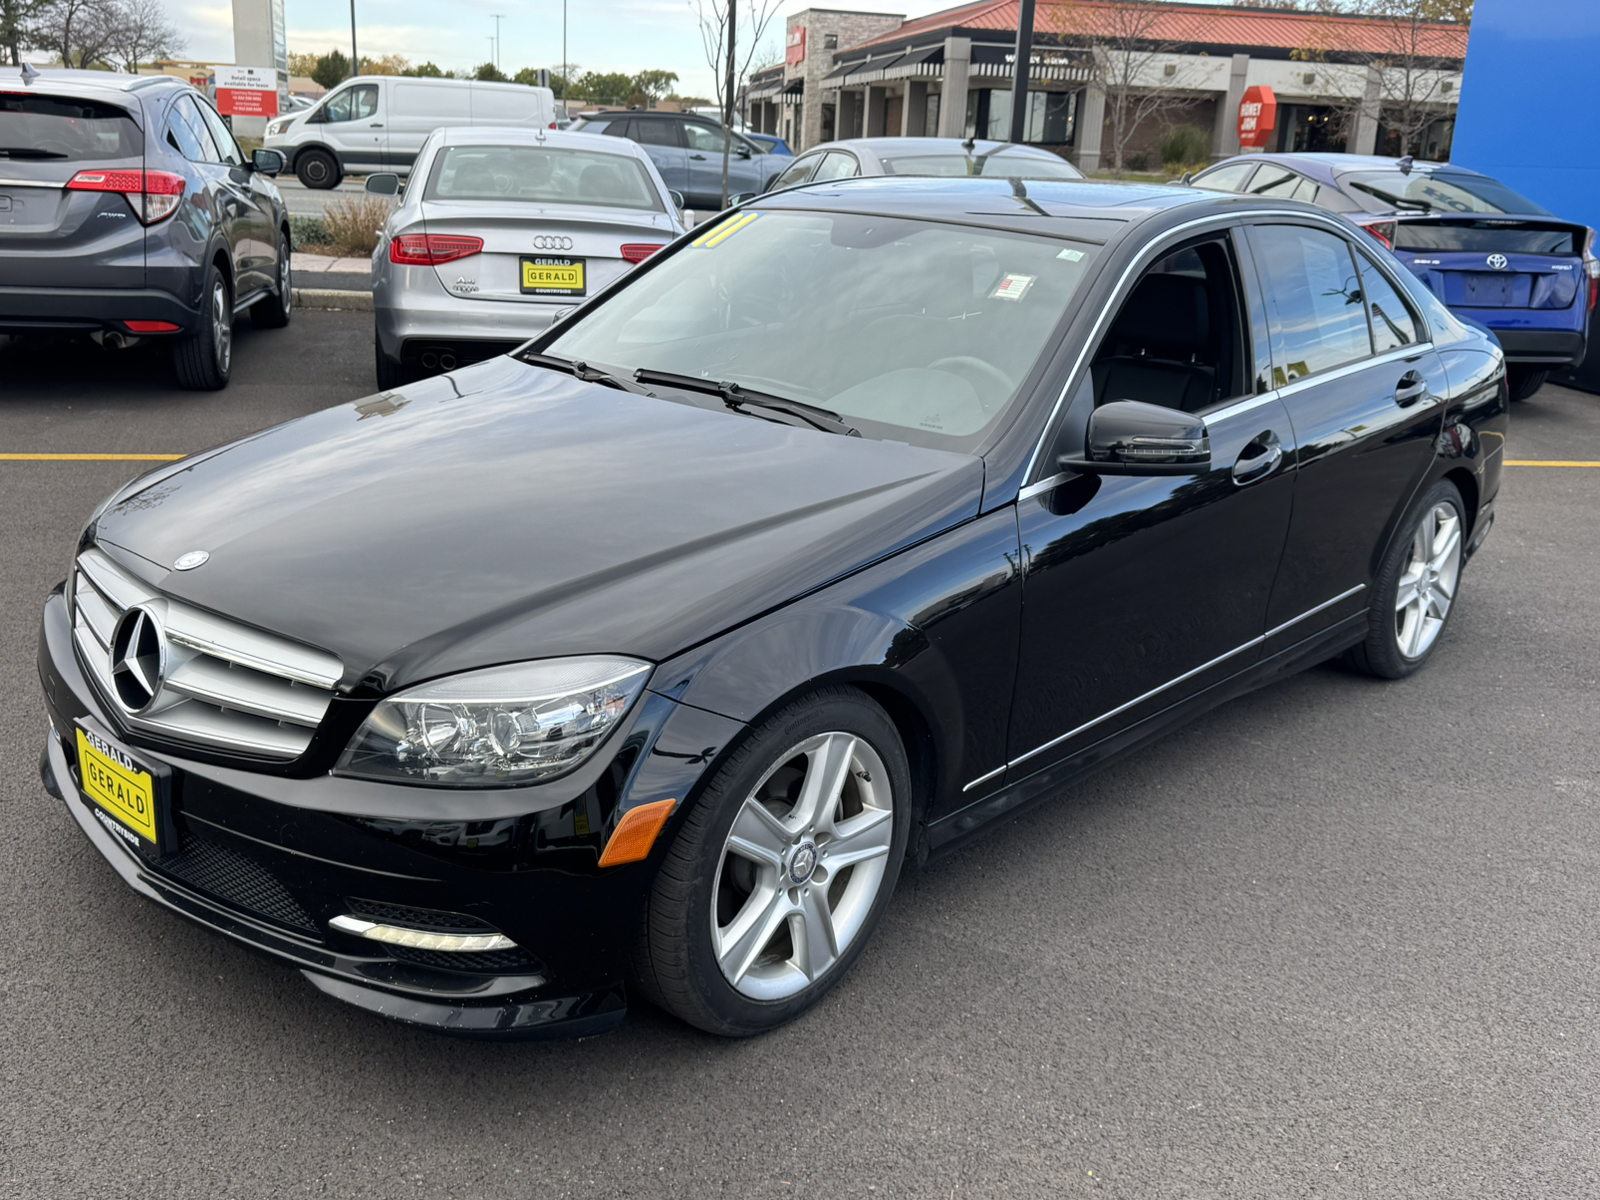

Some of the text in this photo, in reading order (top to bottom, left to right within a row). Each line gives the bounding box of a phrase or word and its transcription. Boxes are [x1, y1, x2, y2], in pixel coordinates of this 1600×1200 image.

[530, 271, 575, 280] GERALD
[535, 258, 571, 267] GERALD
[86, 731, 133, 771] GERALD
[89, 762, 145, 815] GERALD
[94, 808, 140, 846] COUNTRYSIDE
